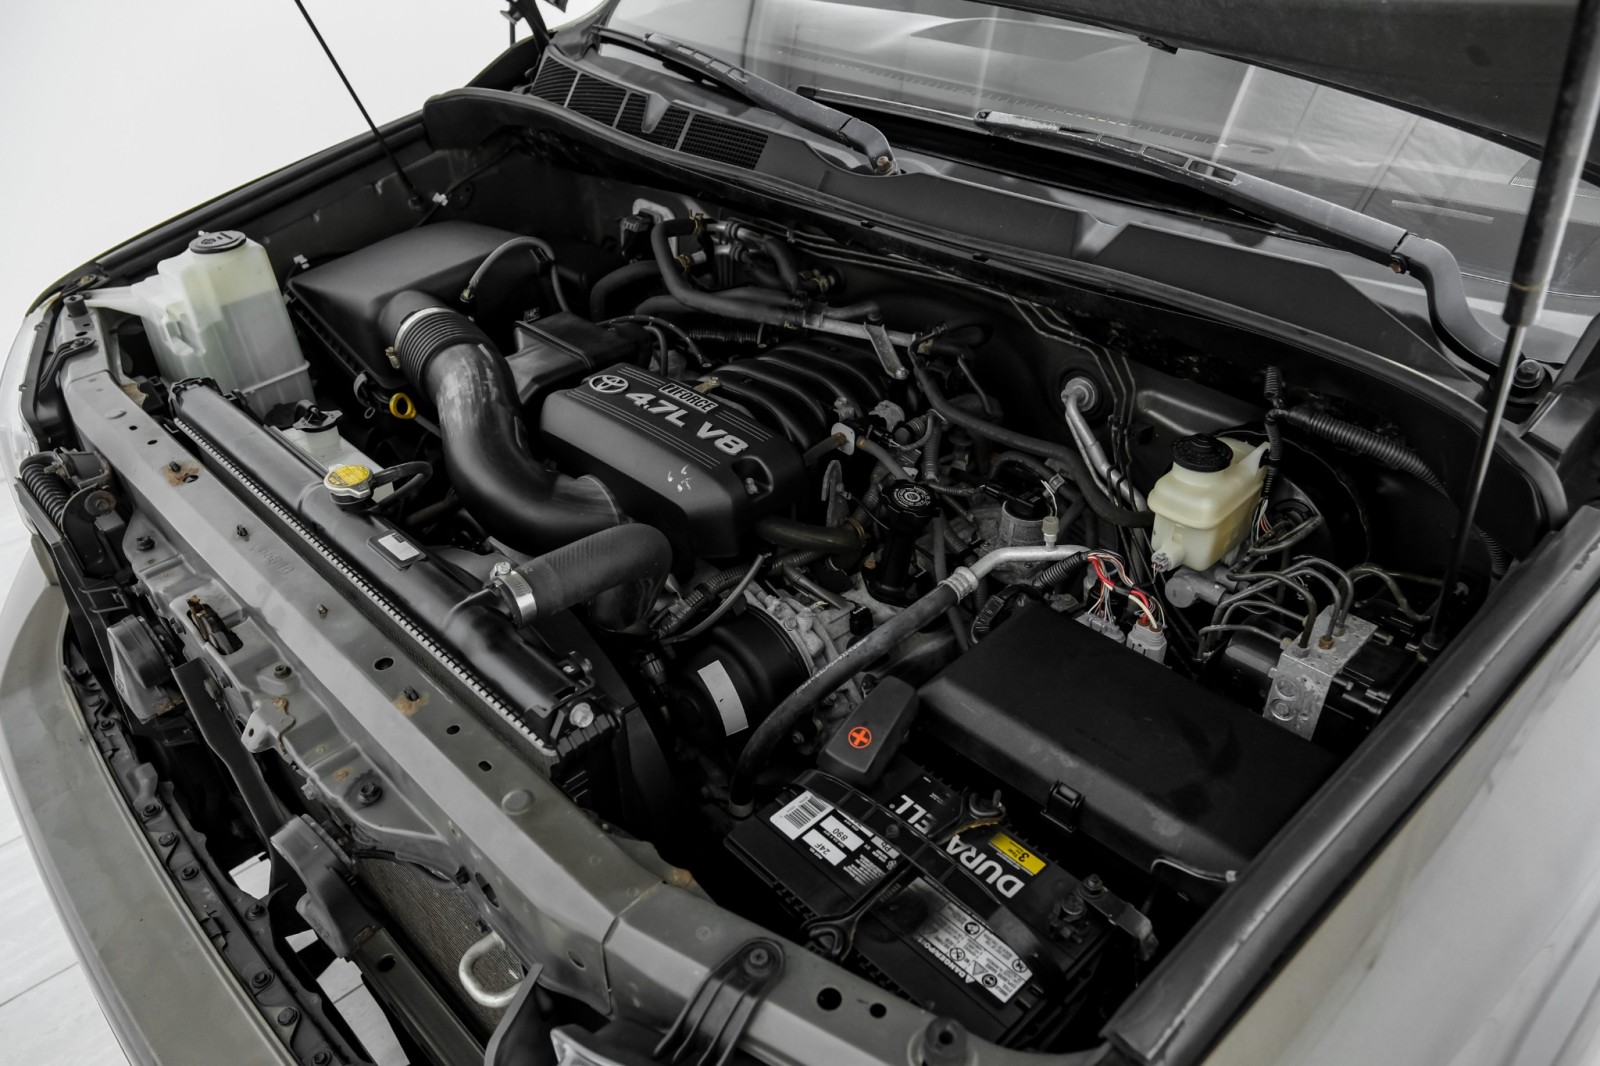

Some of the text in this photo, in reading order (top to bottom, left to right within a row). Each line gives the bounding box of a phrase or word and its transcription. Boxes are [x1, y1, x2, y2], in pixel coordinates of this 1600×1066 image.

[625, 393, 748, 455] 4.7L V8
[832, 827, 849, 842] 890
[814, 842, 831, 856] 24F
[880, 841, 892, 853] Pb
[895, 794, 1025, 898] DURAELL
[1018, 852, 1030, 863] 3
